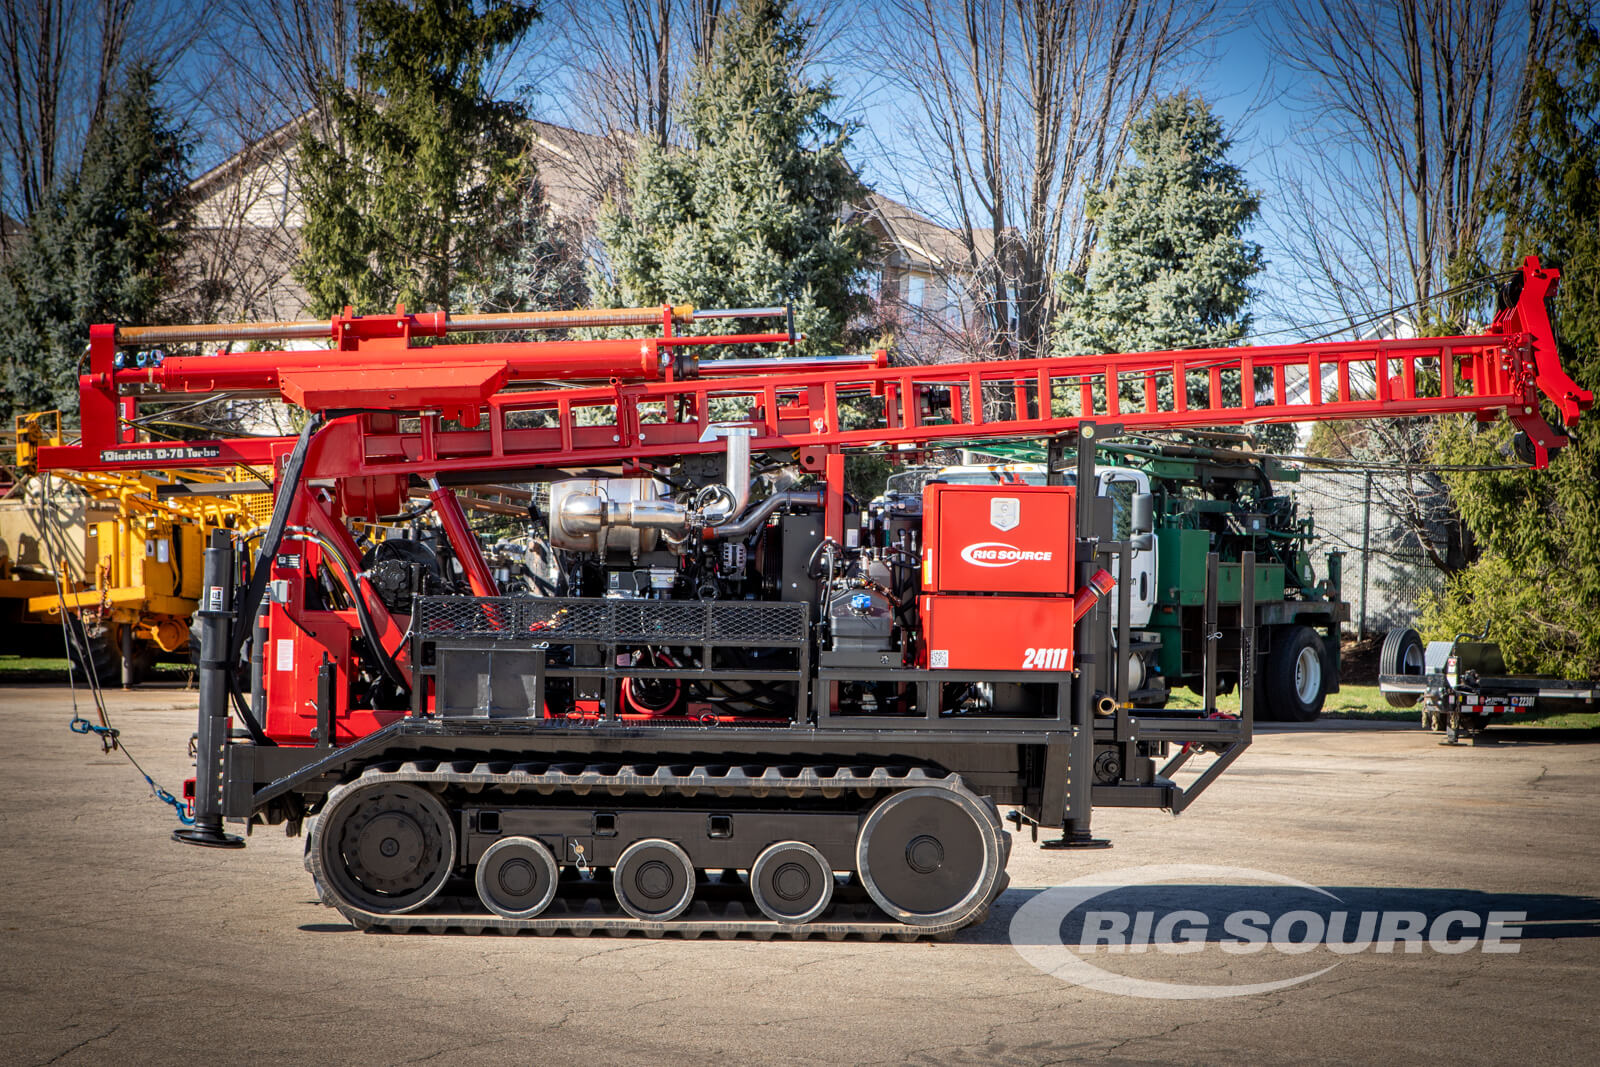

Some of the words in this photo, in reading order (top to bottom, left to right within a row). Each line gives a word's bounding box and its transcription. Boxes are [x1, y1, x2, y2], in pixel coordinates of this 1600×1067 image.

[103, 450, 153, 462] Diedrich
[186, 447, 217, 458] Turbo
[973, 550, 997, 560] RIG
[998, 550, 1052, 561] SOURCE
[1022, 648, 1068, 669] 24111
